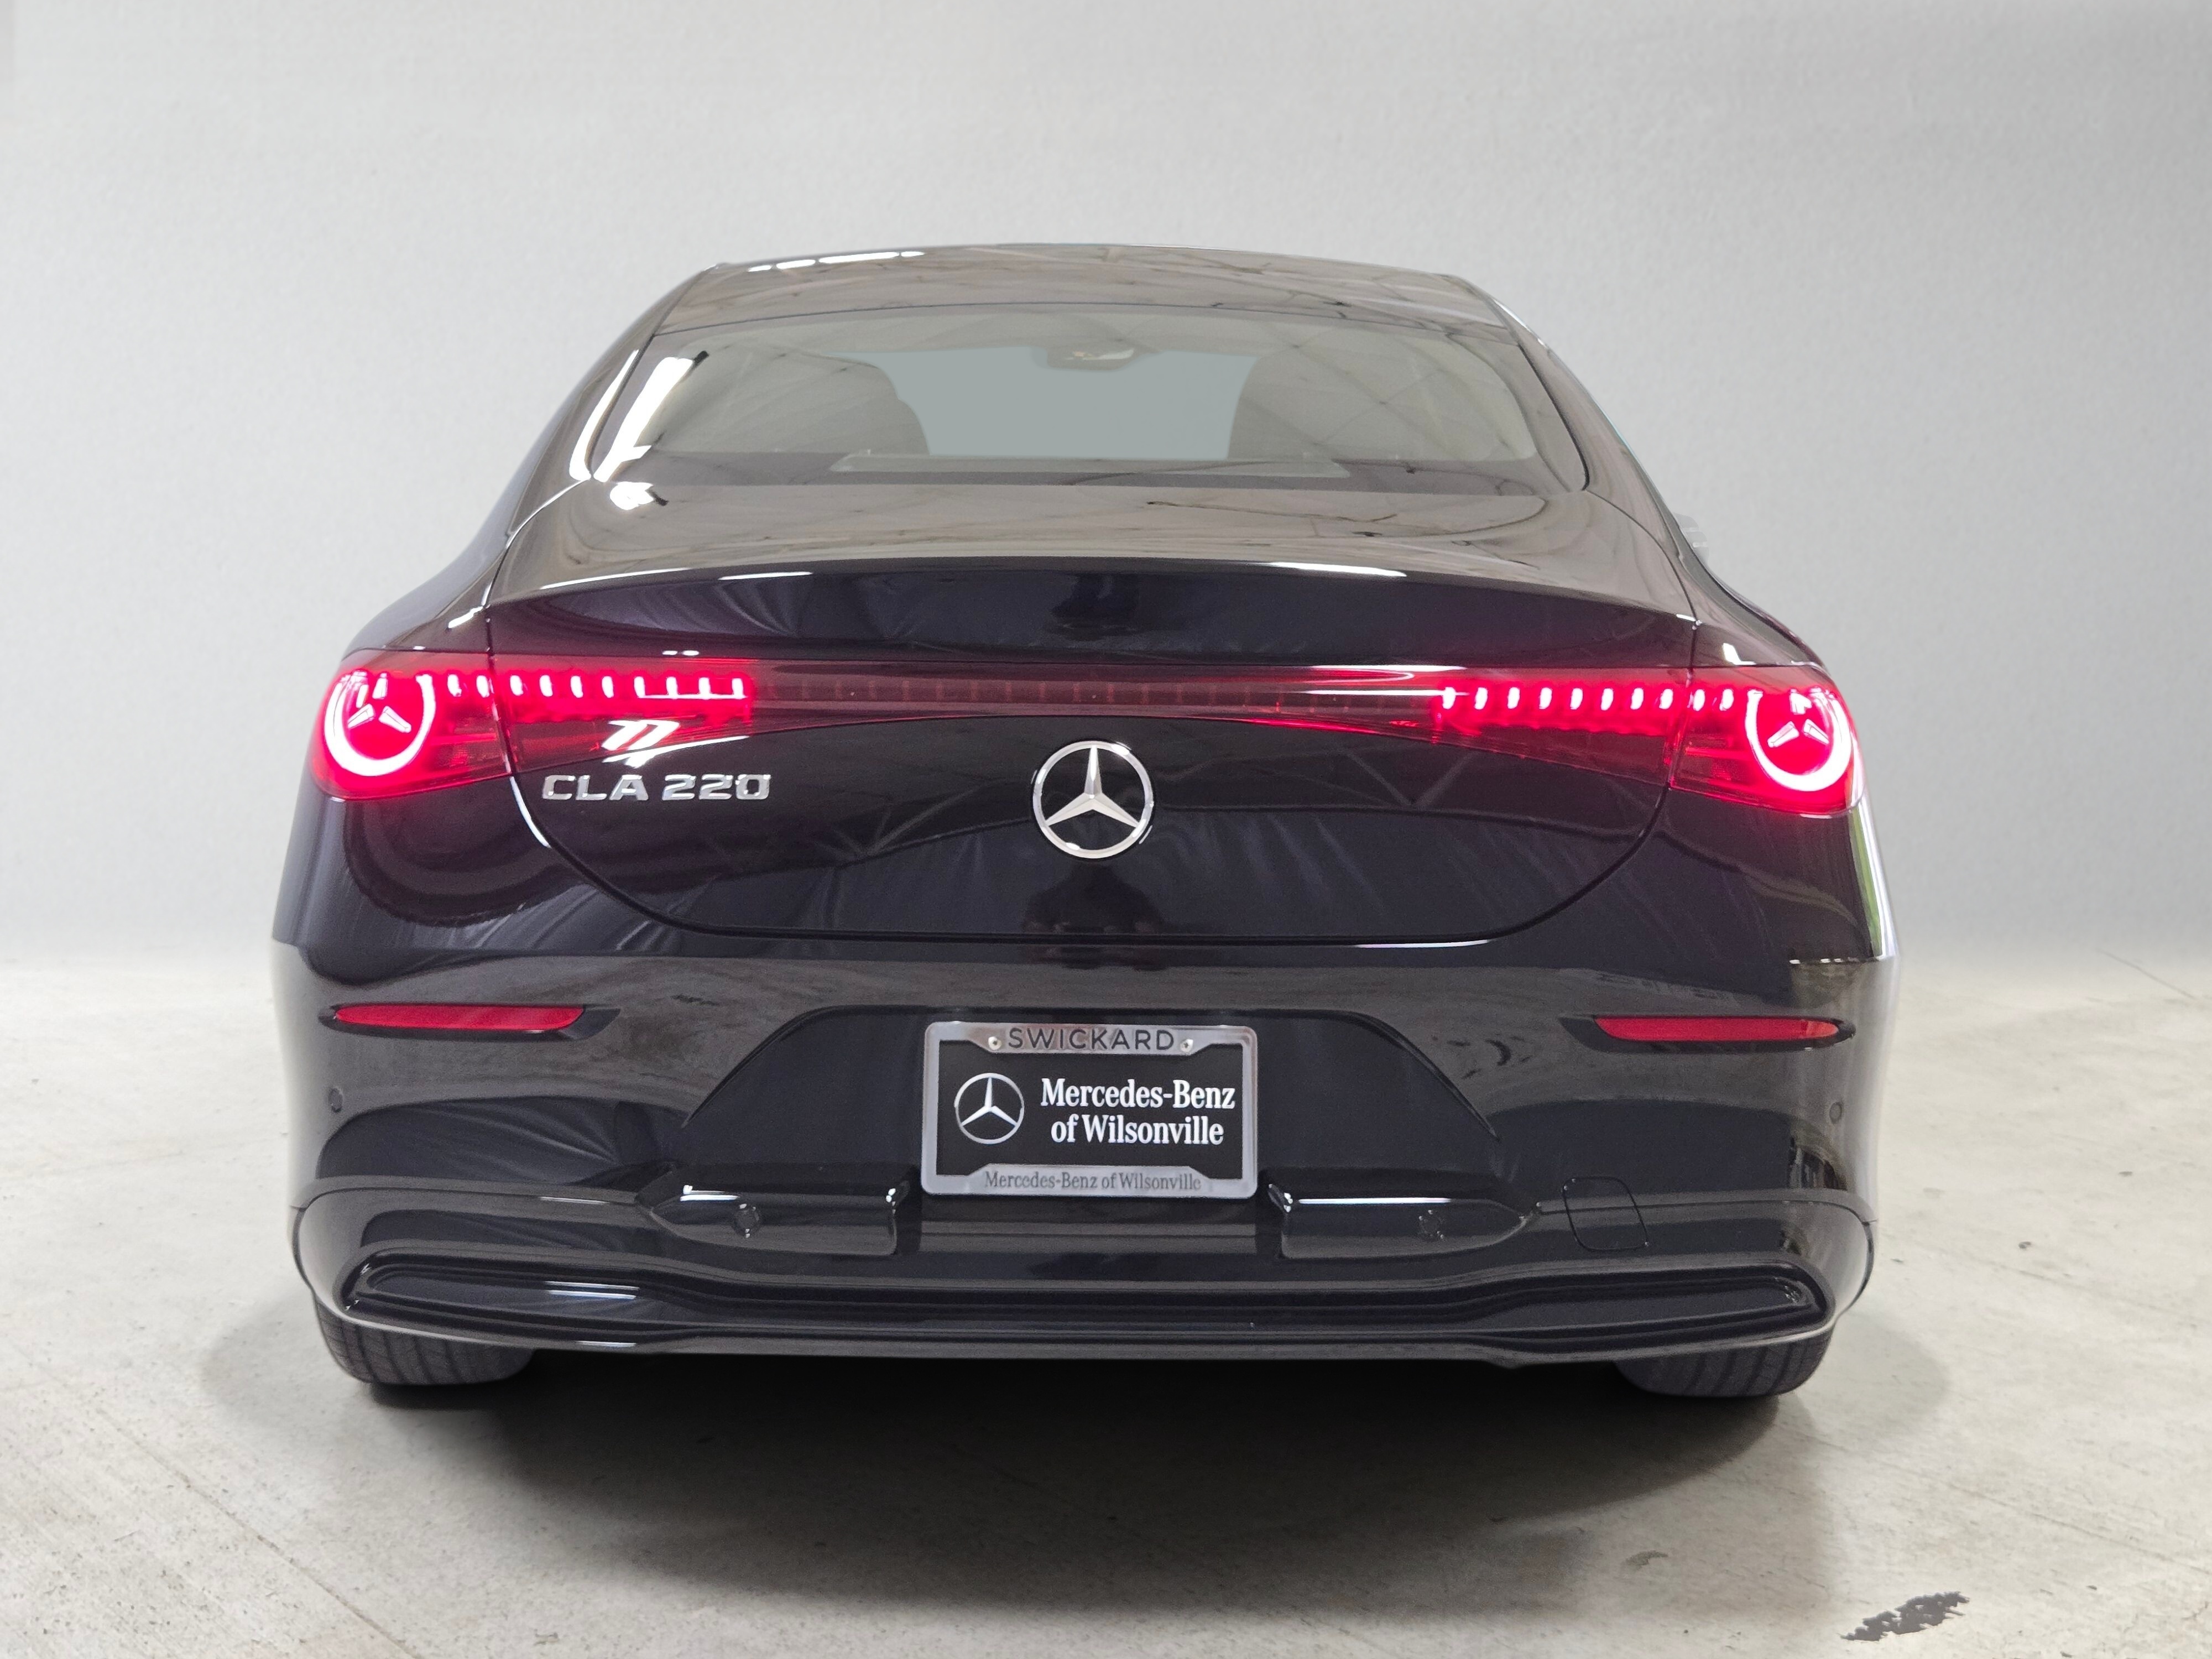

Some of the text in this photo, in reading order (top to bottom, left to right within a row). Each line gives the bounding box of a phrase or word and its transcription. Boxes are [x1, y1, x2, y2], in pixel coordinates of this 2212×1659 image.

[542, 774, 771, 800] CLA 220
[1009, 1027, 1175, 1051] SWICKARD
[1041, 1078, 1236, 1109] Mercedes-Benz
[1051, 1114, 1224, 1145] of Wilsonville
[984, 1171, 1202, 1191] Mercedes-Benz of Wilsonville
